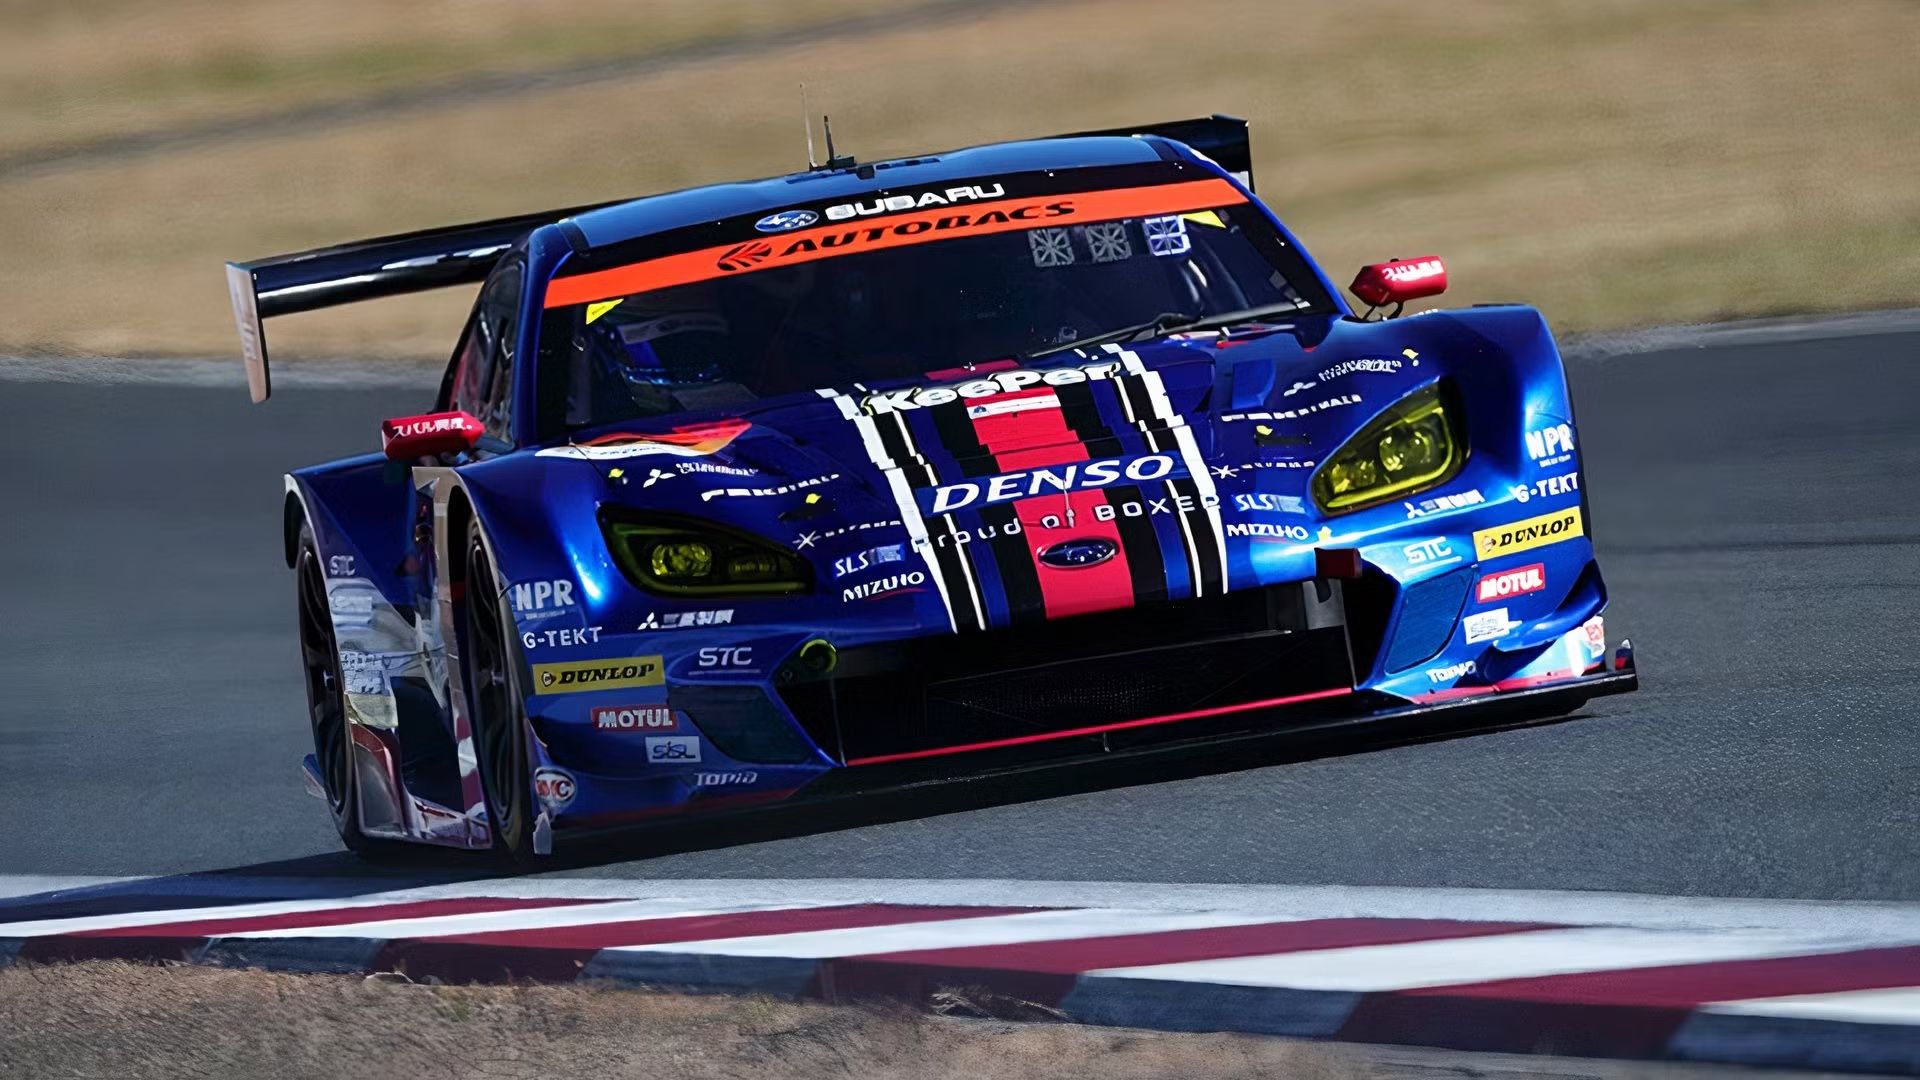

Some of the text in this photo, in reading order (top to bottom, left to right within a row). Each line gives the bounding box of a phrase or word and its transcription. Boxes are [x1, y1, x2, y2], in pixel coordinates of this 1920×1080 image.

[825, 183, 1005, 221] SUBARU
[780, 201, 1076, 258] AUTOBACS
[1525, 423, 1575, 460] NPR
[932, 455, 1174, 513] DENSO
[1500, 516, 1576, 547] DUNLOP
[835, 550, 869, 577] SLS
[515, 579, 575, 611] NPR
[1479, 568, 1544, 600] MOTUL
[523, 627, 603, 649] G-TEKT
[699, 647, 753, 666] STC
[558, 664, 655, 685] DUNLOP
[598, 708, 674, 729] MOTUL
